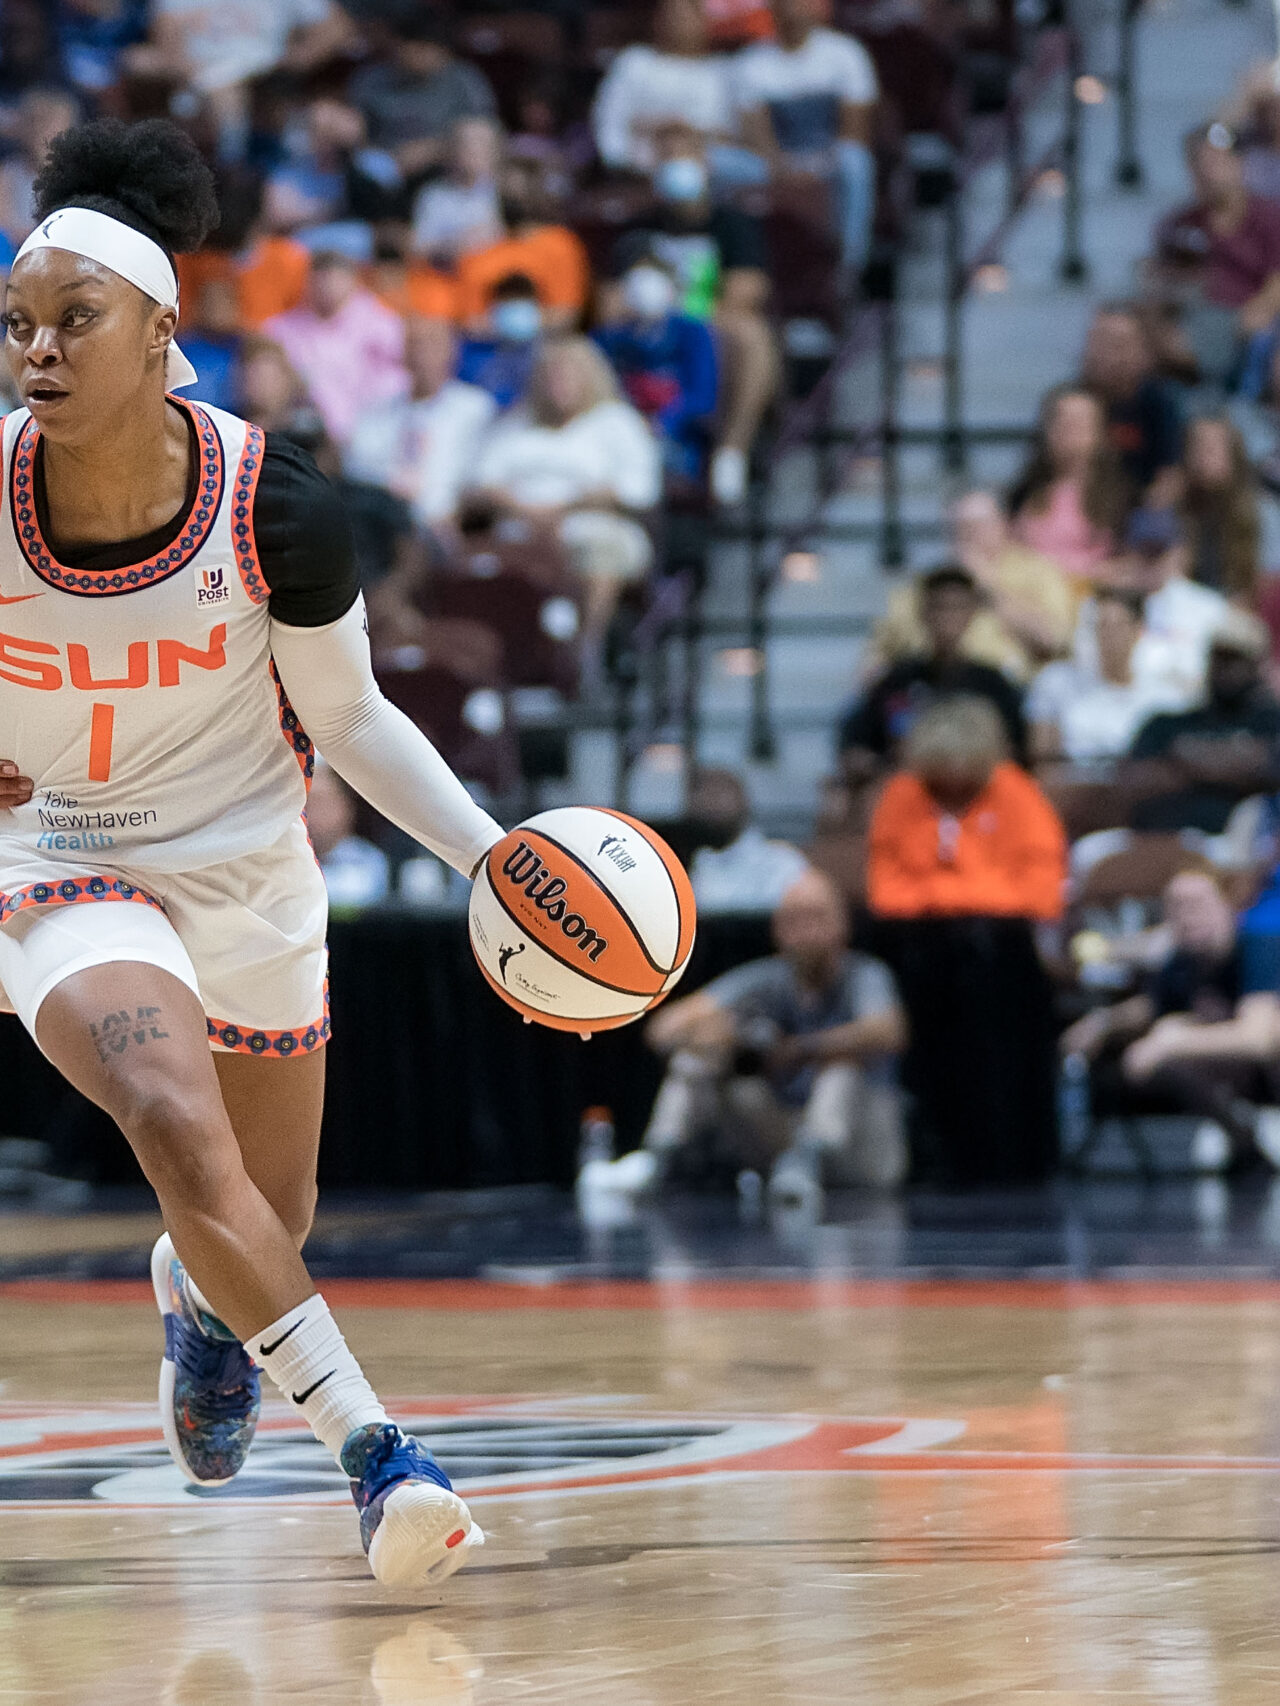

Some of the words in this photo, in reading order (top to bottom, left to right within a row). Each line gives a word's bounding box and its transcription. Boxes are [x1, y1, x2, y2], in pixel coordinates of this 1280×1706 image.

[197, 586, 229, 601] Post
[88, 702, 115, 783] 1
[40, 789, 79, 809] Yale
[37, 808, 158, 829] NewHaven
[36, 829, 114, 850] Health
[502, 841, 609, 964] Wilson
